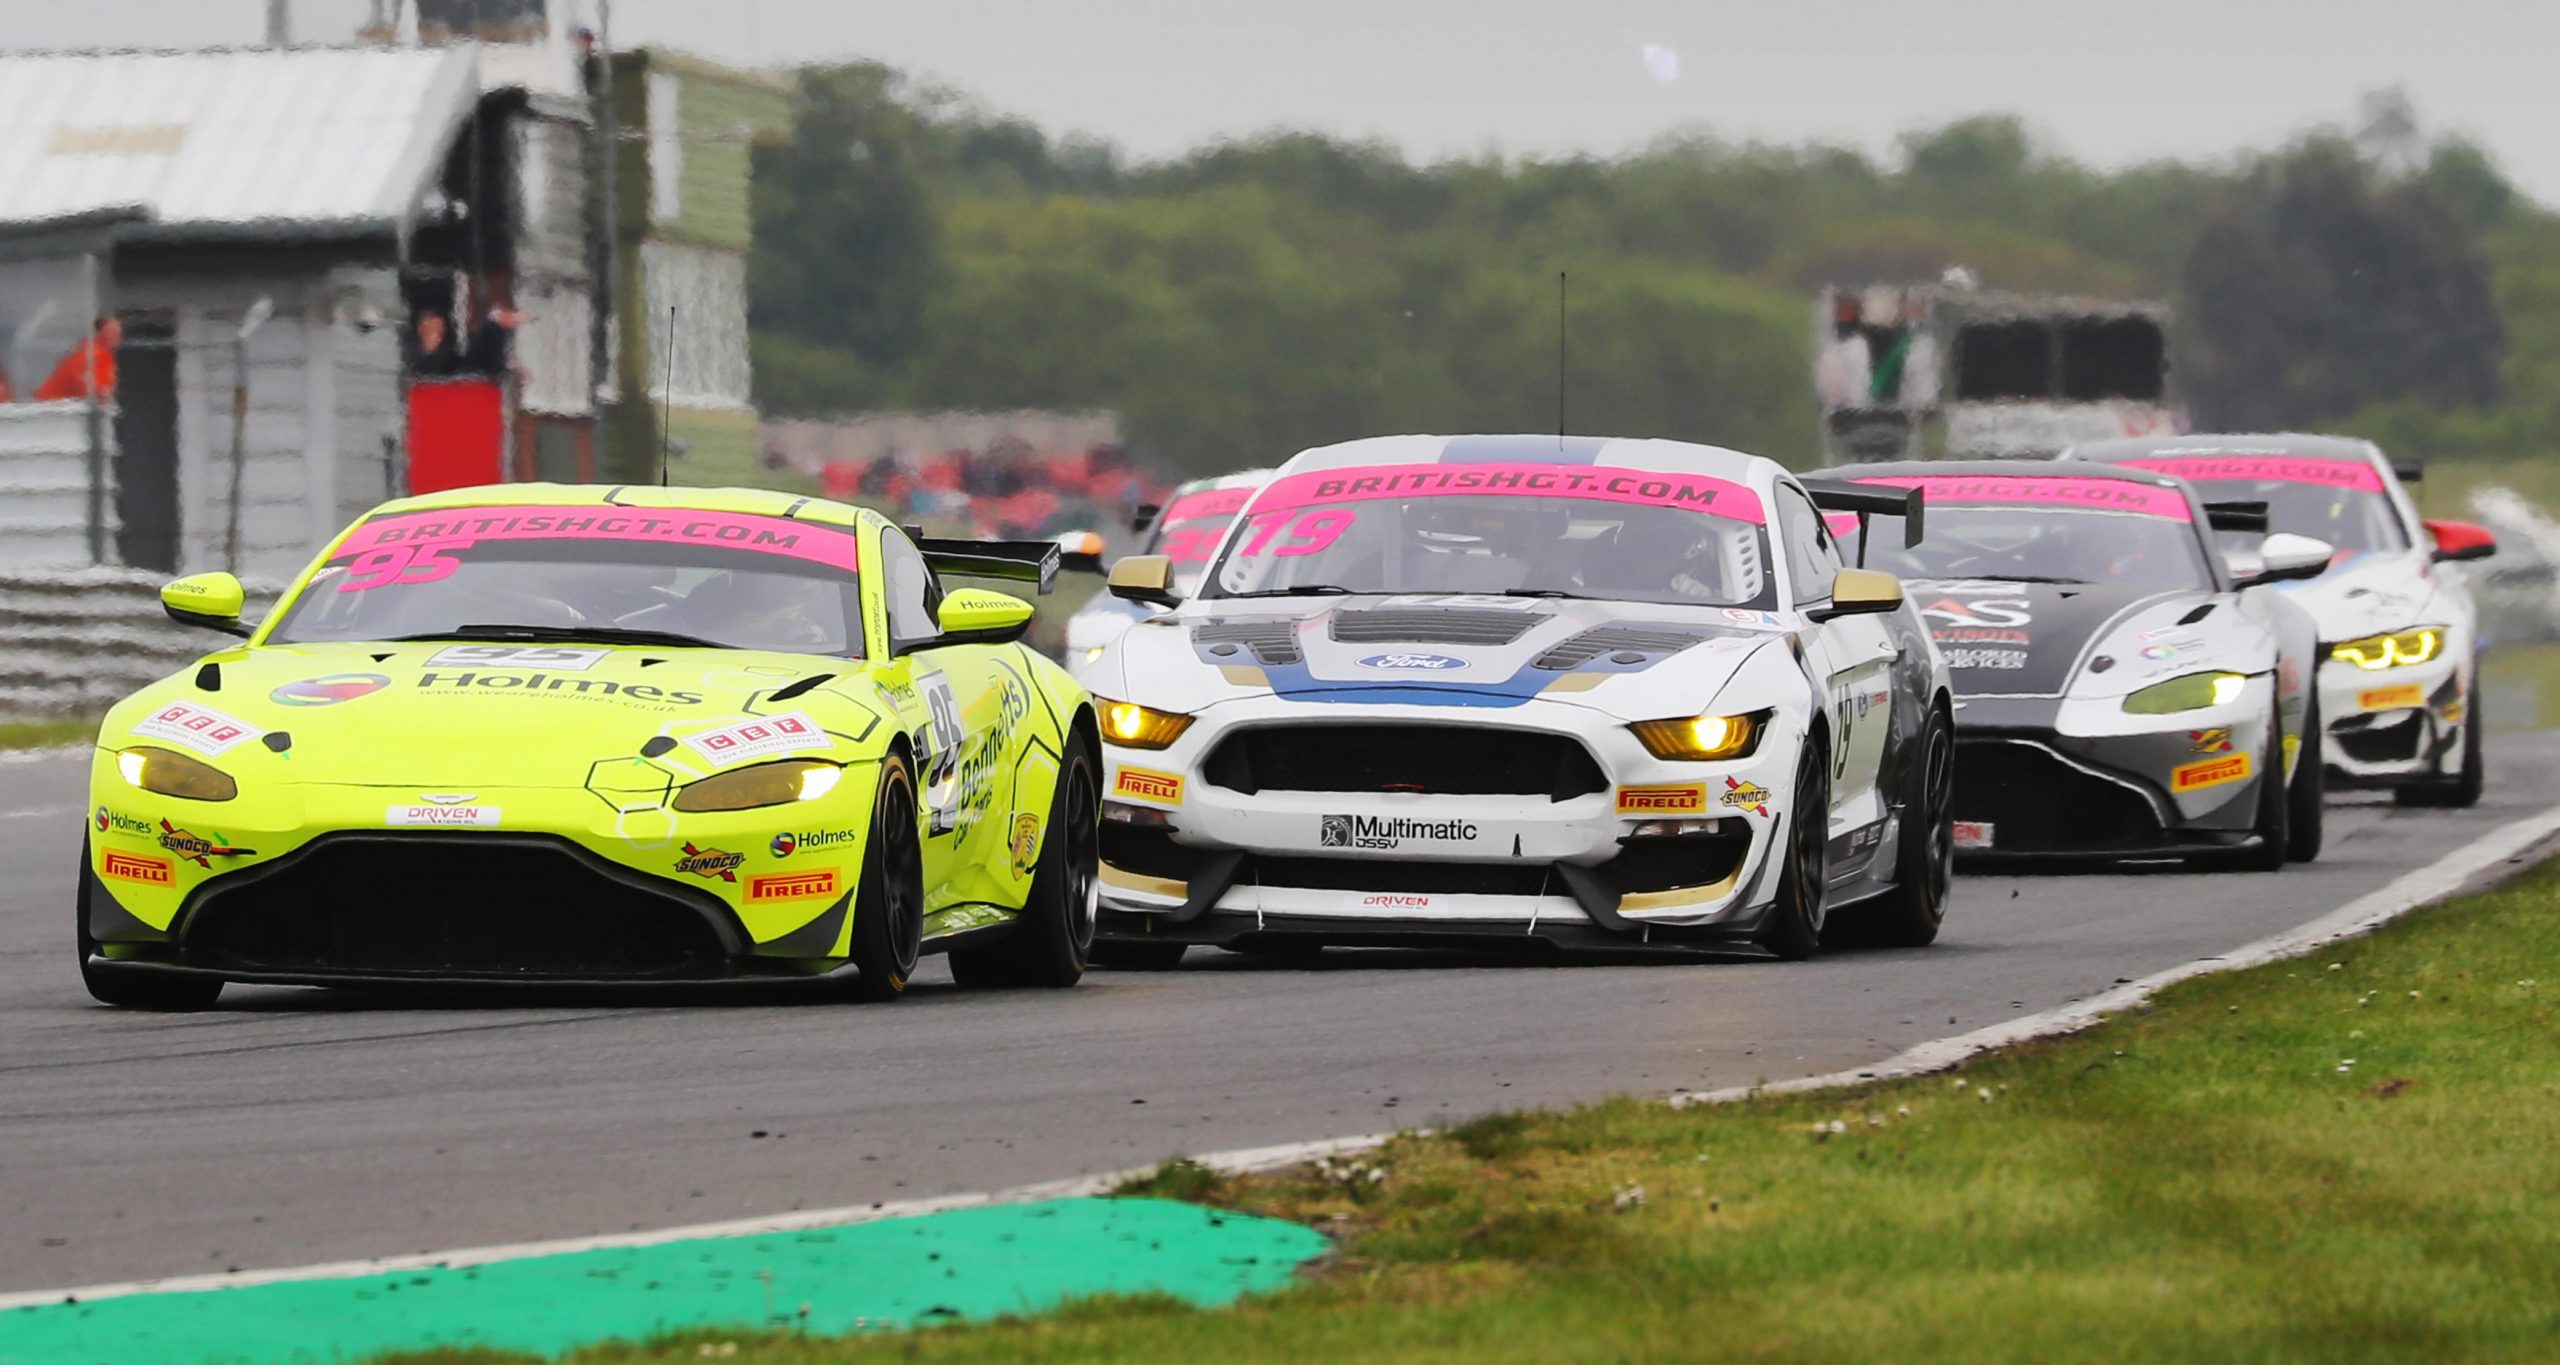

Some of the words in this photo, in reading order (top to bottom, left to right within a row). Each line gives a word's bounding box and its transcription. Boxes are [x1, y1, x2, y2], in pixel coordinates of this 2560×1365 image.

[1314, 472, 1720, 506] BRITISHGT.COM
[1927, 483, 2150, 505] SHGT.COM
[374, 516, 801, 549] BRITISHGT.COM
[1239, 509, 1358, 558] 19
[337, 540, 477, 593] 95
[960, 600, 1021, 610] Holmes
[1376, 654, 1450, 669] Ford
[417, 673, 703, 705] Holmes
[705, 719, 804, 750] CEF
[961, 679, 1023, 811] Bennetts
[1119, 771, 1178, 798] PIRELLI
[1619, 789, 1699, 808] PIRELLI
[1725, 790, 1769, 804] SUNOCO
[111, 811, 151, 833] Holmes
[408, 808, 478, 823] DRIVEN
[798, 829, 855, 847] Holmes
[1356, 815, 1477, 840] Multimatic
[162, 836, 212, 855] SUNOCO
[106, 853, 168, 882] PIRELLI
[679, 852, 741, 872] SUNOCO
[752, 873, 833, 898] PIRELLI
[1363, 896, 1429, 908] DRIVEN
